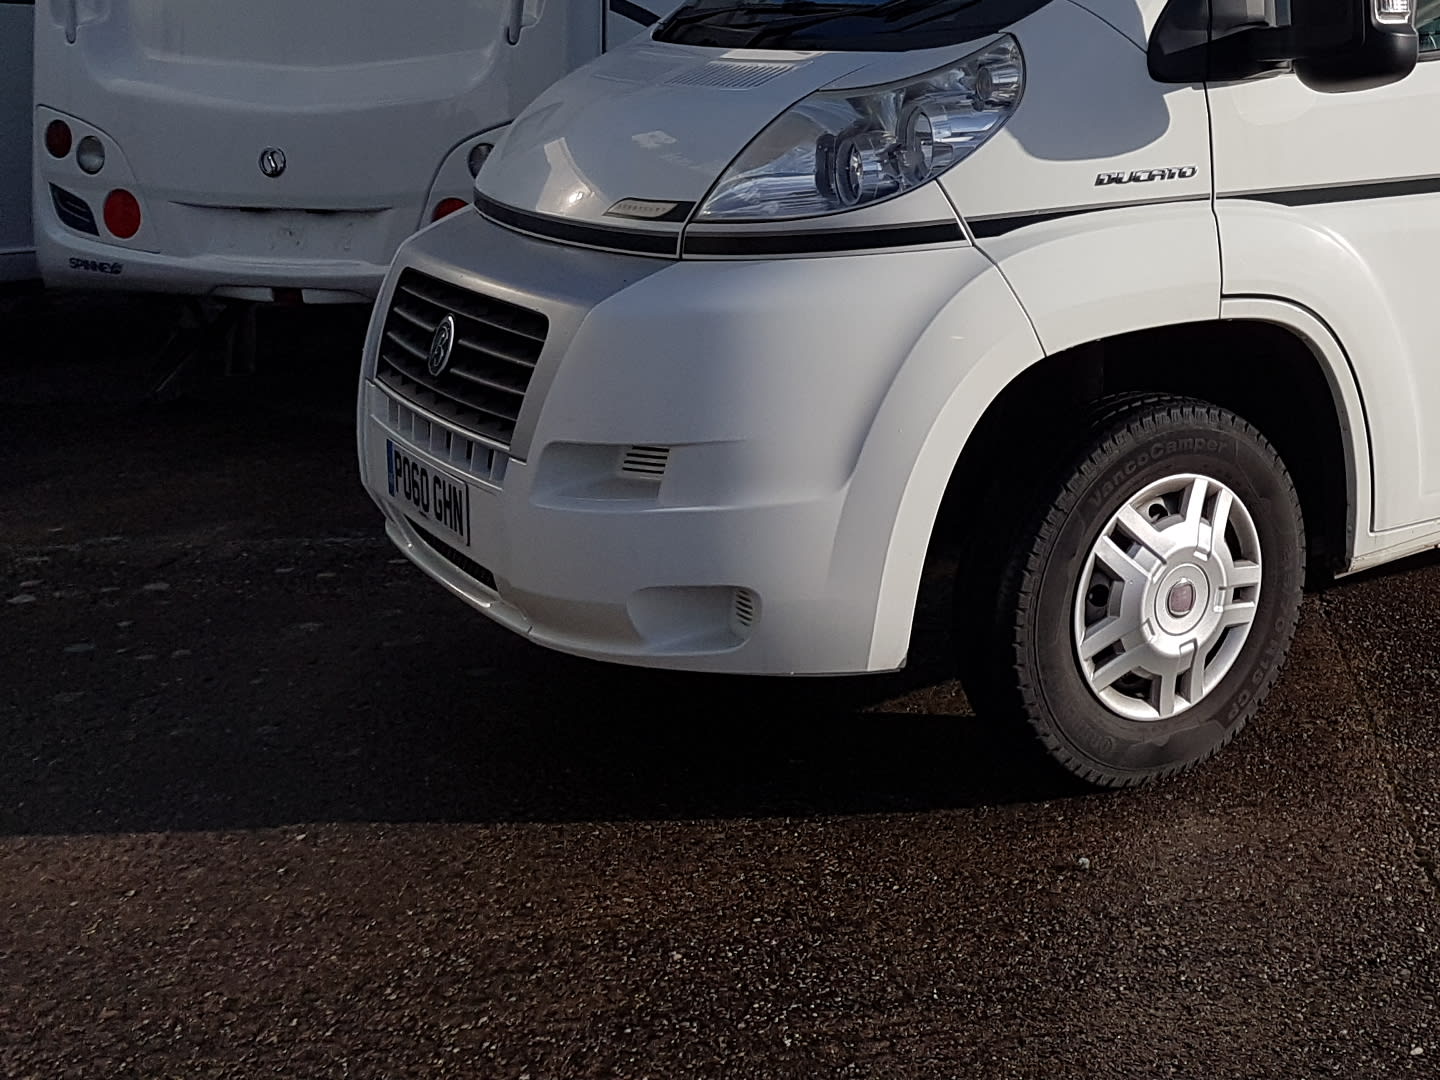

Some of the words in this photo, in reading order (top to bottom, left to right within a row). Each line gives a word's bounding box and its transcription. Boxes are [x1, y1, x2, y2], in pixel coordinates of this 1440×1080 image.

[1094, 165, 1198, 187] DUCATO
[394, 449, 430, 513] PO60
[433, 475, 464, 537] GHN
